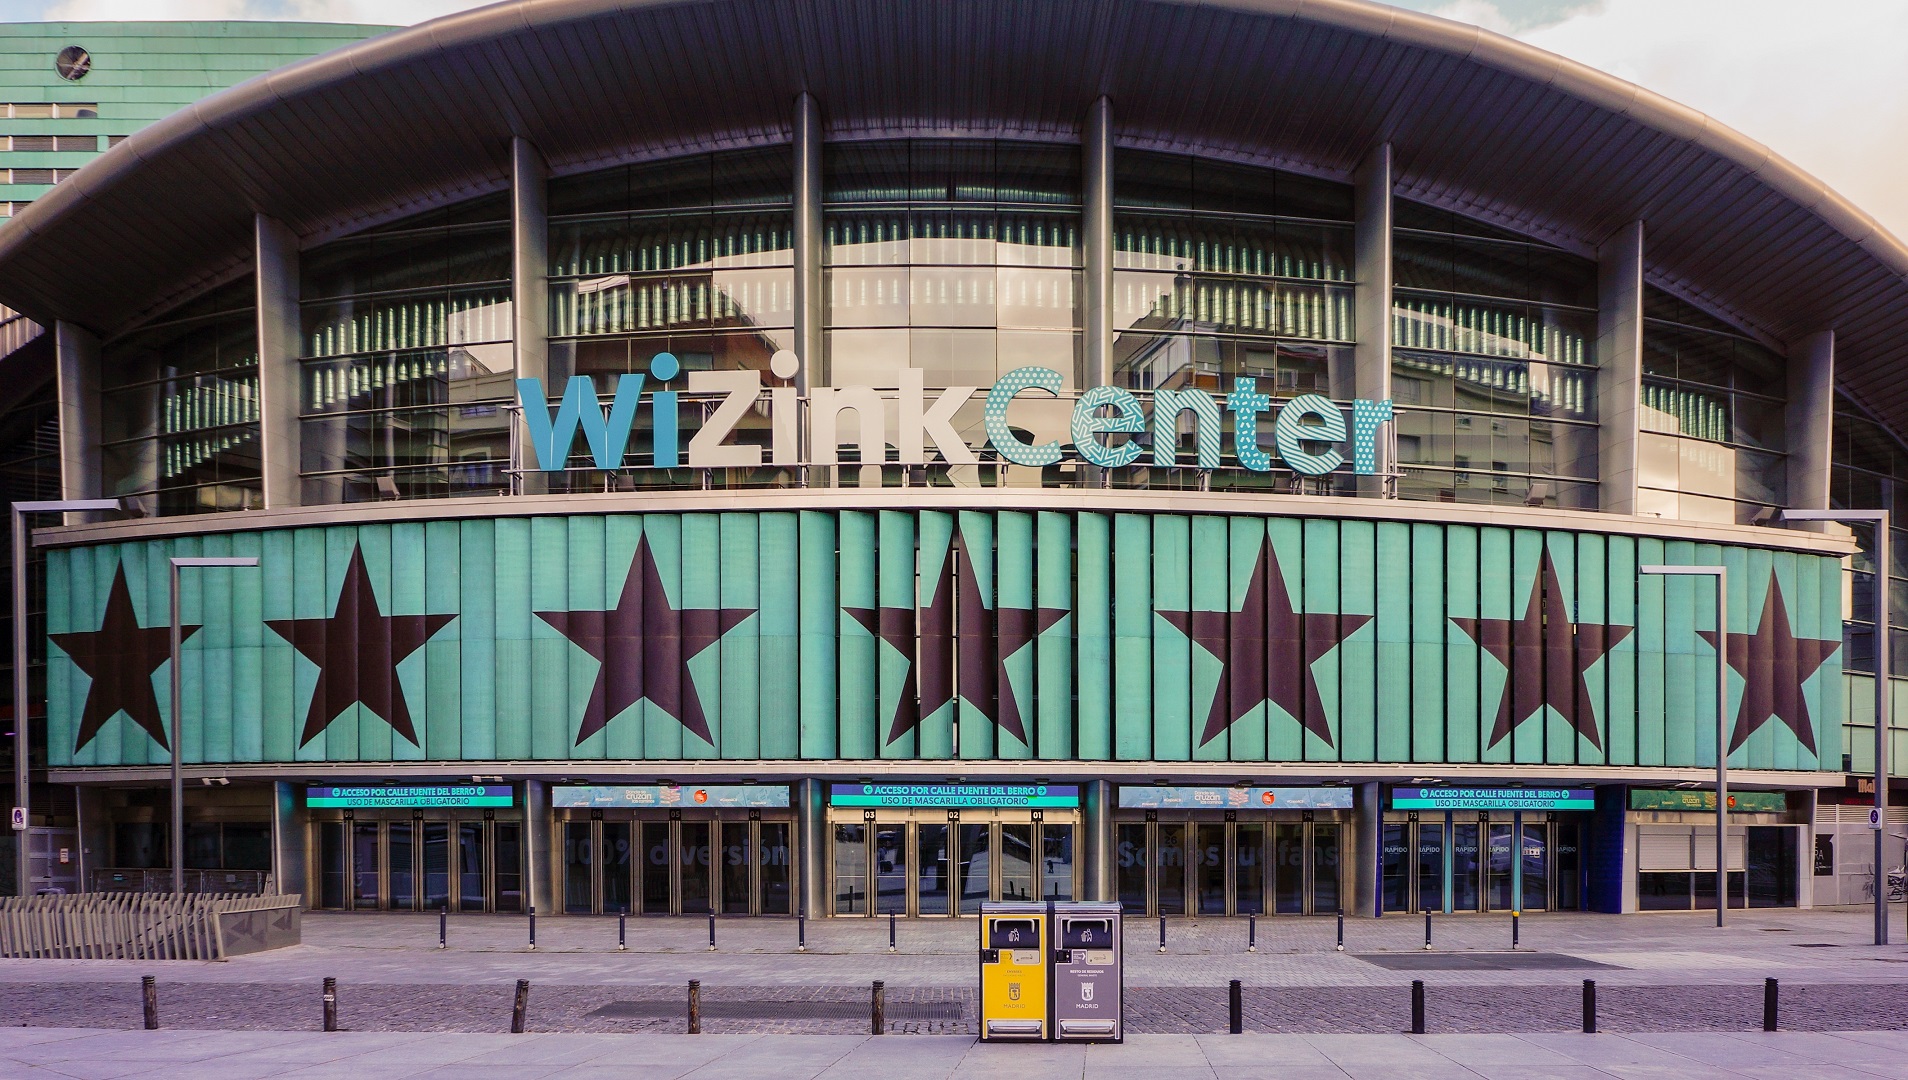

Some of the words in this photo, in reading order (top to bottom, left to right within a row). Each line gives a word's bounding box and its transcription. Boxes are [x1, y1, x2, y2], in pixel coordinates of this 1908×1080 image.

[341, 788, 370, 796] ACCESO
[371, 788, 386, 796] POR
[387, 788, 409, 796] CALLE
[410, 787, 436, 796] FUENTE
[437, 787, 450, 796] DEL
[451, 787, 475, 796] BERRO
[875, 786, 910, 795] ACCESO
[911, 786, 929, 795] POR
[930, 786, 956, 795] CALLE
[957, 786, 990, 795] FUENTE
[991, 786, 1006, 795] DEL
[1007, 786, 1035, 795] BERRO
[1429, 789, 1458, 797] ACCESO
[1459, 789, 1474, 797] POR
[1476, 790, 1497, 798] CALLE
[1498, 790, 1523, 798] FUENTE
[1524, 790, 1537, 798] DEL
[1538, 790, 1560, 798] BERRO
[347, 798, 363, 806] USO
[364, 798, 372, 806] DE
[374, 798, 418, 806] MASCARILLA
[420, 797, 469, 806] OBLIGATORIO
[881, 797, 900, 805] USO
[902, 797, 912, 805] DE
[915, 797, 968, 805] MASCARILLA
[970, 797, 1029, 805] OBLIGATORIO
[1435, 799, 1450, 807] USO
[1452, 799, 1461, 807] DE
[1462, 799, 1506, 807] MASCARILLA
[1508, 799, 1556, 808] OBLIGATORIO
[650, 838, 790, 866] dversión
